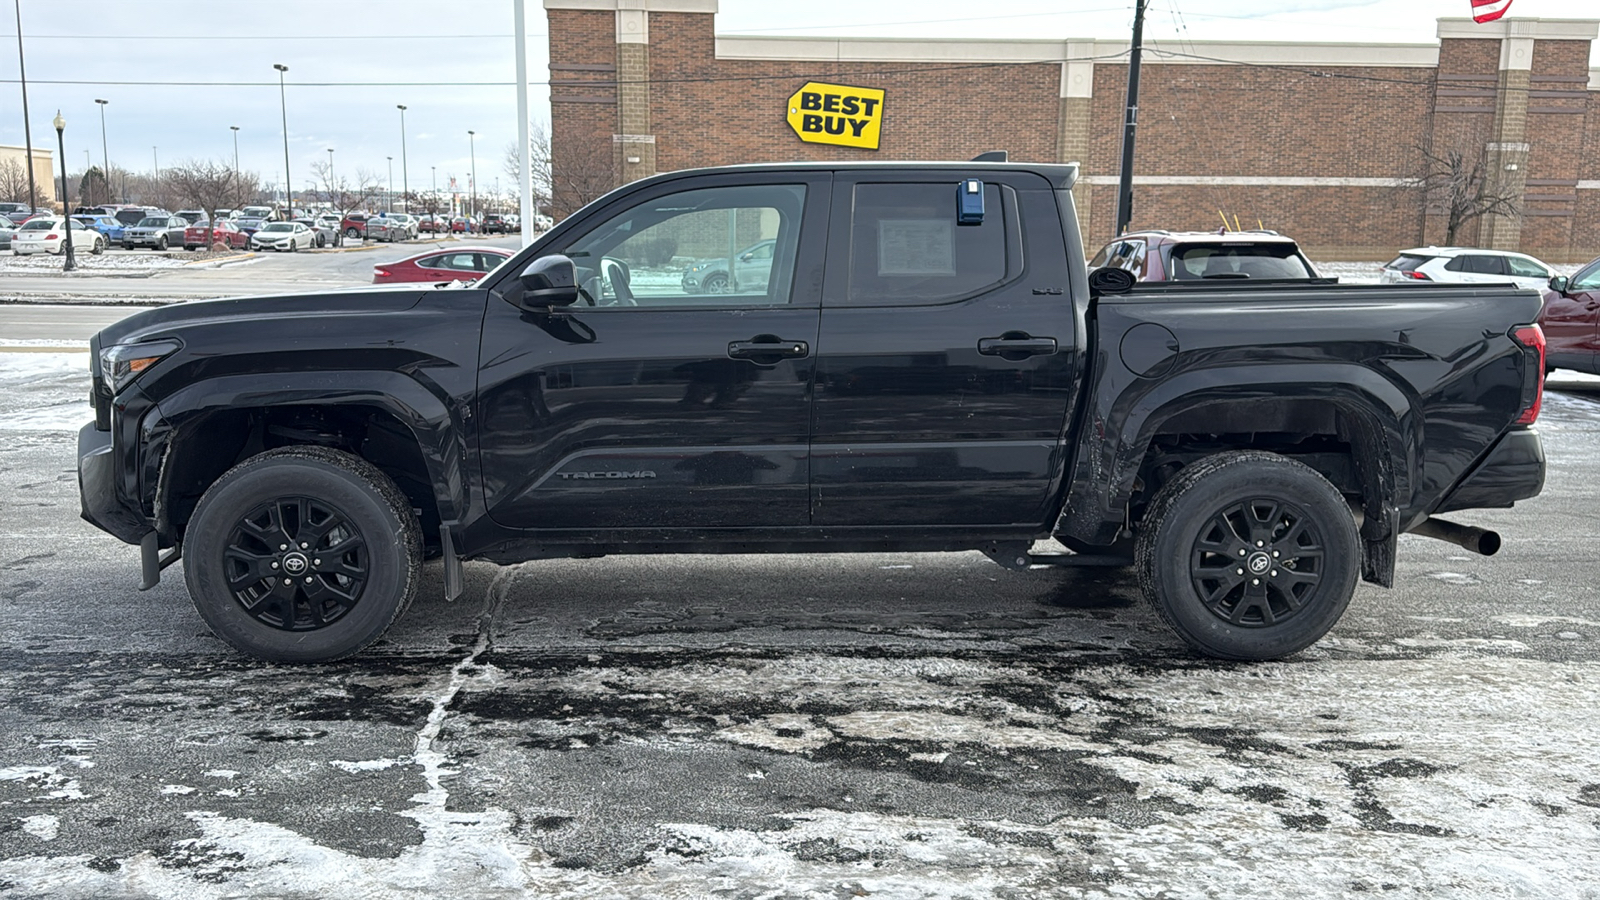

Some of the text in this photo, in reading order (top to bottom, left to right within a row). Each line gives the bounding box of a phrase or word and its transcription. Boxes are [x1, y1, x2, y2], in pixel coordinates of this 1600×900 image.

[801, 92, 879, 117] BEST
[802, 114, 870, 137] BUY
[556, 470, 657, 480] TACOMA
